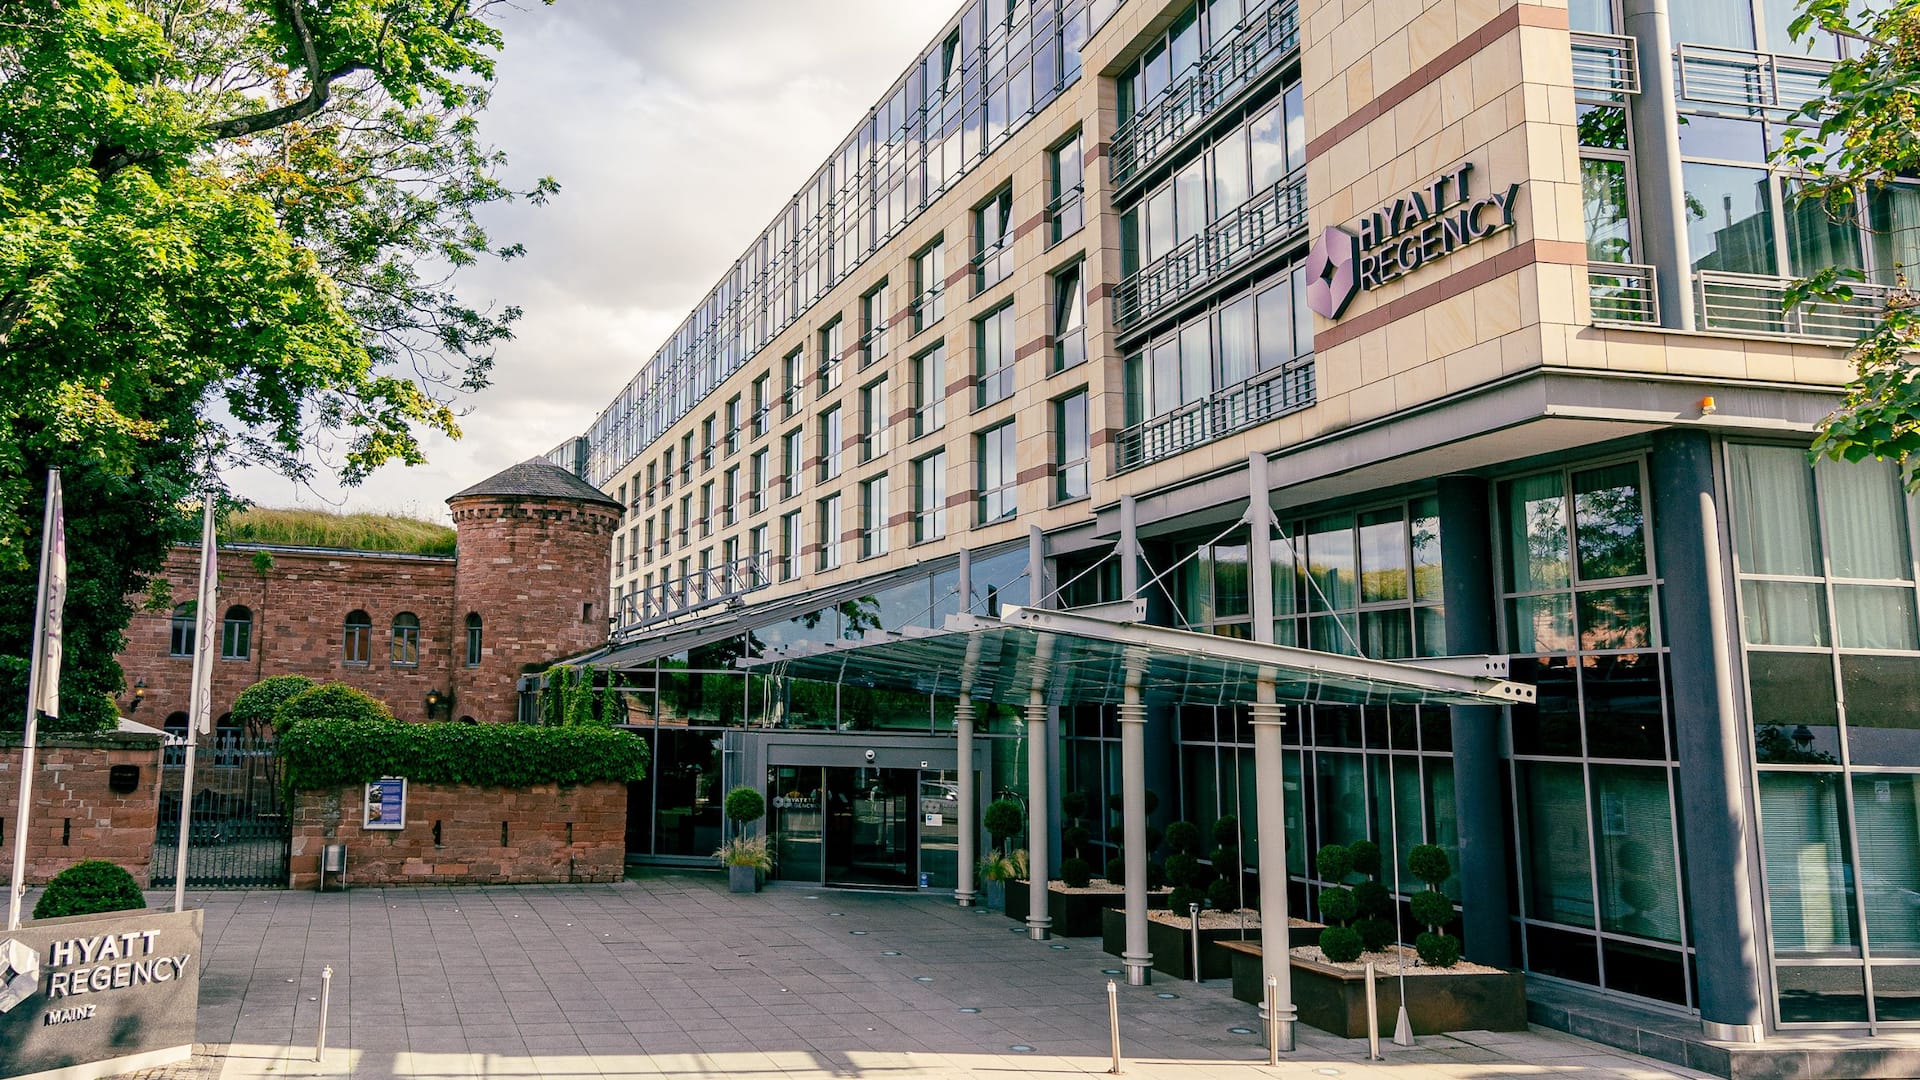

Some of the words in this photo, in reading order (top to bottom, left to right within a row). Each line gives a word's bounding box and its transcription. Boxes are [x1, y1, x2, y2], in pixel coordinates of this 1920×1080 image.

[1359, 162, 1473, 251] HYATT
[1360, 183, 1519, 291] REGENCY
[53, 929, 160, 967] HYATT
[50, 954, 191, 998] REGENCY
[48, 1004, 97, 1024] MAINZ
